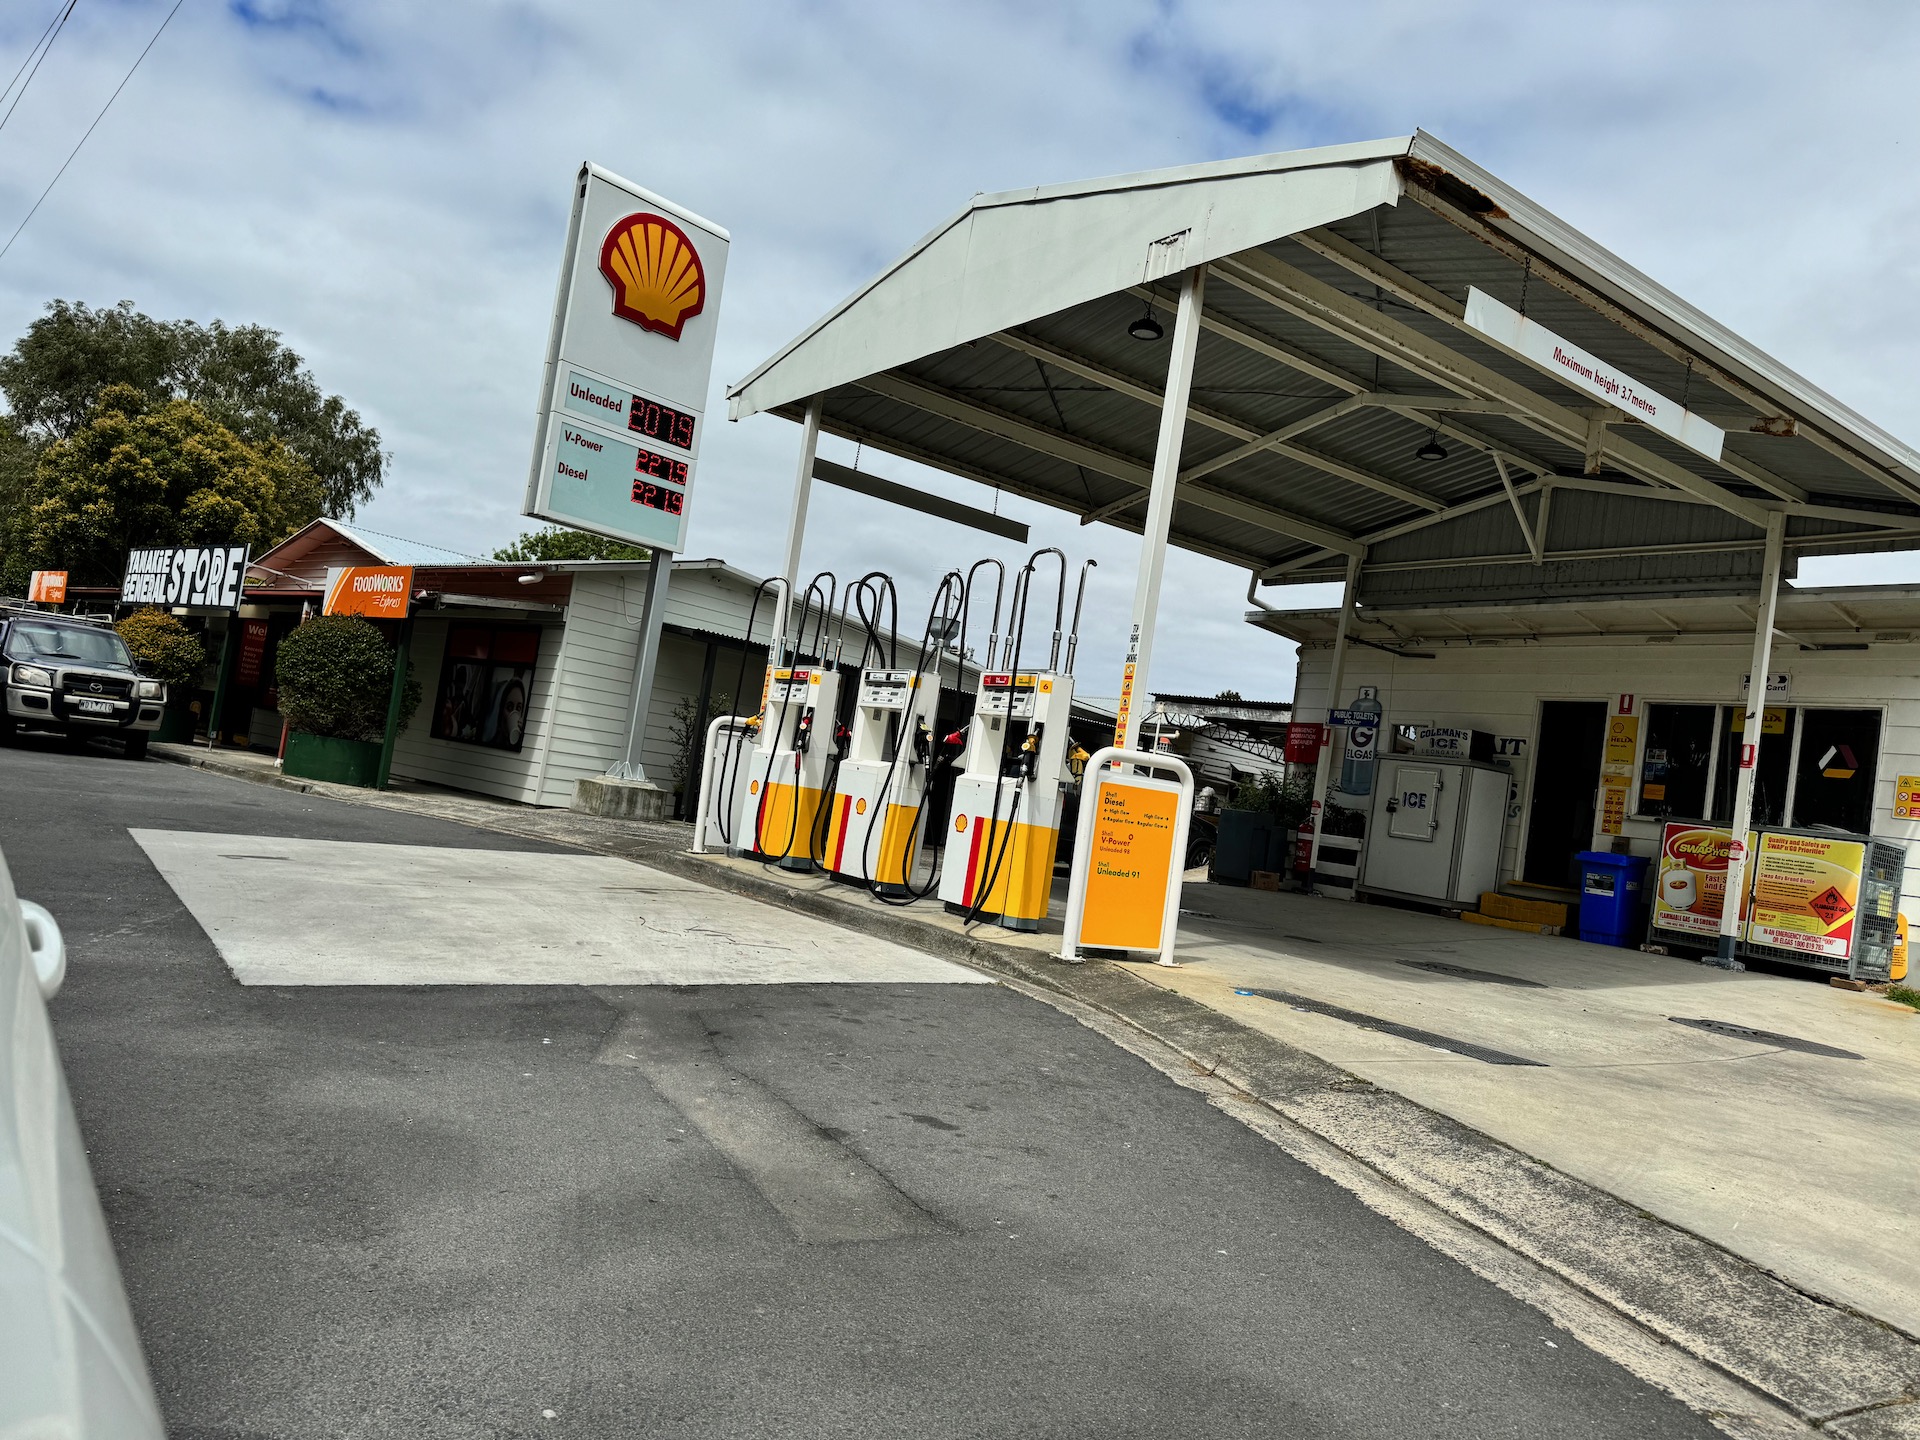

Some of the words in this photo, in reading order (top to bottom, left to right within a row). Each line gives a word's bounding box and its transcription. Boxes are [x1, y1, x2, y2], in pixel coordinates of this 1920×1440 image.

[1553, 346, 1593, 380] Maximum
[1594, 369, 1619, 395] height
[1621, 386, 1633, 401] 3.7
[1631, 395, 1657, 416] metres
[570, 382, 622, 413] Unleaded
[565, 430, 604, 452] V-Power
[557, 462, 588, 481] Diesel
[167, 547, 245, 607] STORE
[353, 573, 405, 593] FOODWORKS
[123, 573, 167, 603] GENERAL
[379, 594, 401, 612] Express
[1333, 710, 1352, 719] PUBLIC
[1353, 711, 1374, 720] TOILETS
[1420, 728, 1468, 740] COLEMAN'S
[1429, 738, 1459, 749] ICE
[1346, 748, 1373, 759] ELGAS
[1104, 797, 1125, 807] Diesel
[1402, 792, 1427, 809] ICE
[1107, 816, 1123, 824] Regular
[1101, 836, 1131, 847] V-Power
[1768, 836, 1788, 846] Quality
[1801, 840, 1820, 849] Safety
[1099, 845, 1123, 854] Unleaded
[1678, 843, 1730, 858] SWAP'n'G
[1798, 847, 1825, 855] Priorities
[1097, 867, 1130, 878] Unleaded
[1704, 882, 1718, 890] and
[1815, 903, 1839, 912] FLAMMABLE
[1659, 912, 1682, 922] FLAMMABLE
[1682, 915, 1691, 923] GAS
[1700, 918, 1719, 927] SMOKING
[1775, 929, 1802, 940] EMERGENCY
[1802, 933, 1822, 943] CONTACT
[1779, 938, 1794, 946] ELGAS
